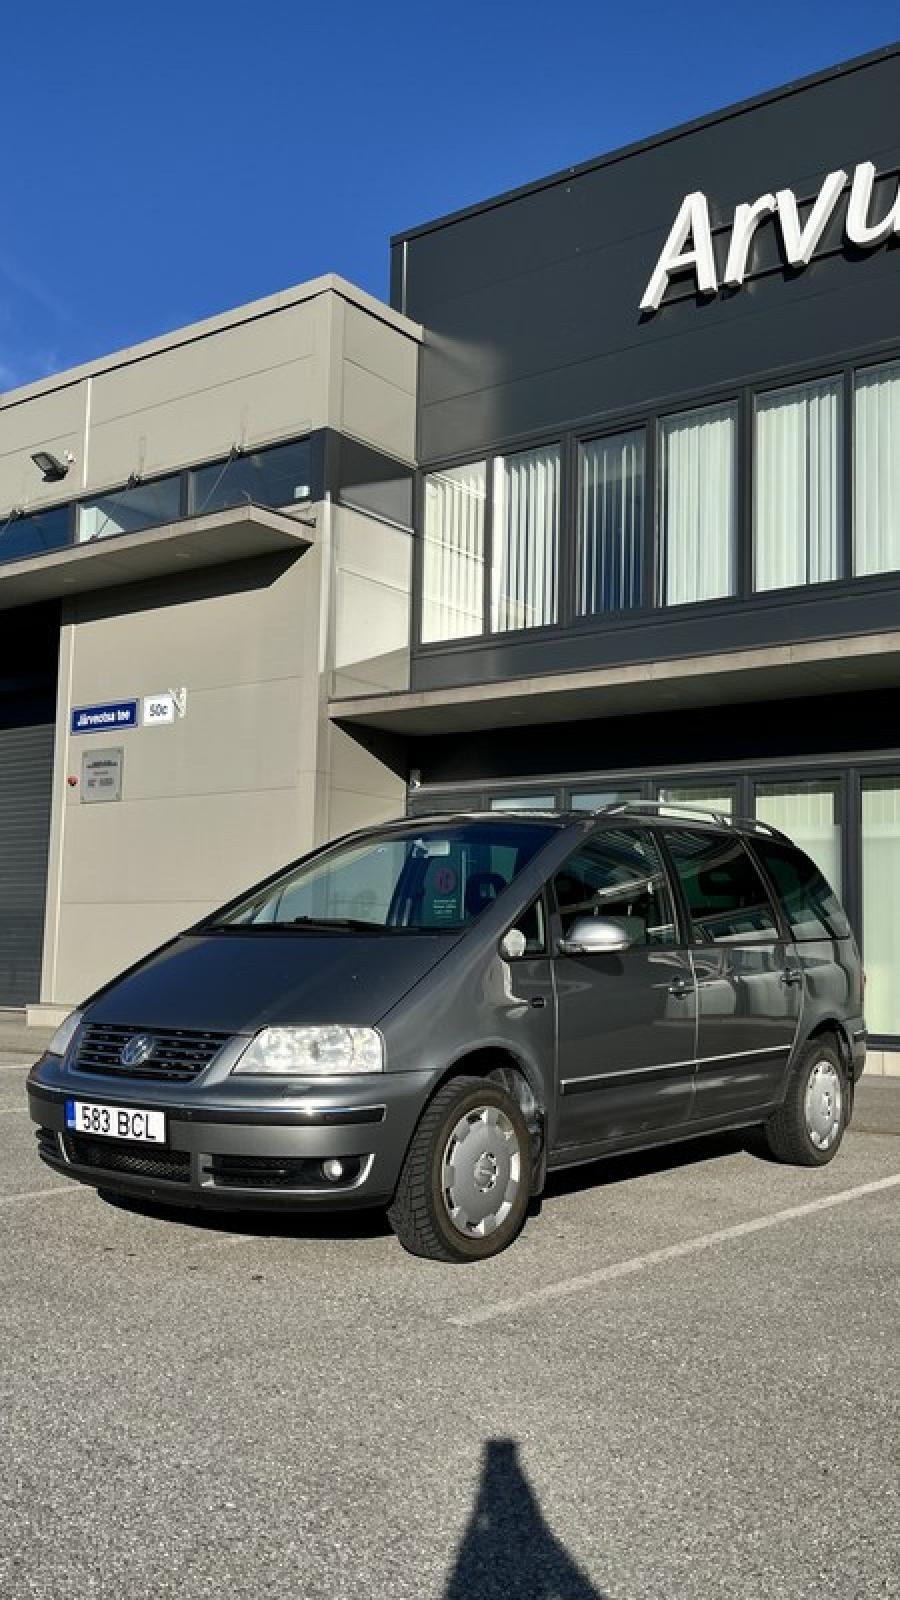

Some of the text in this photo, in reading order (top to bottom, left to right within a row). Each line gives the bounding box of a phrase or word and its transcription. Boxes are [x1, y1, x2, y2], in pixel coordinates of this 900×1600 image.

[117, 709, 131, 721] tee
[81, 1105, 156, 1140] 583 BCL
